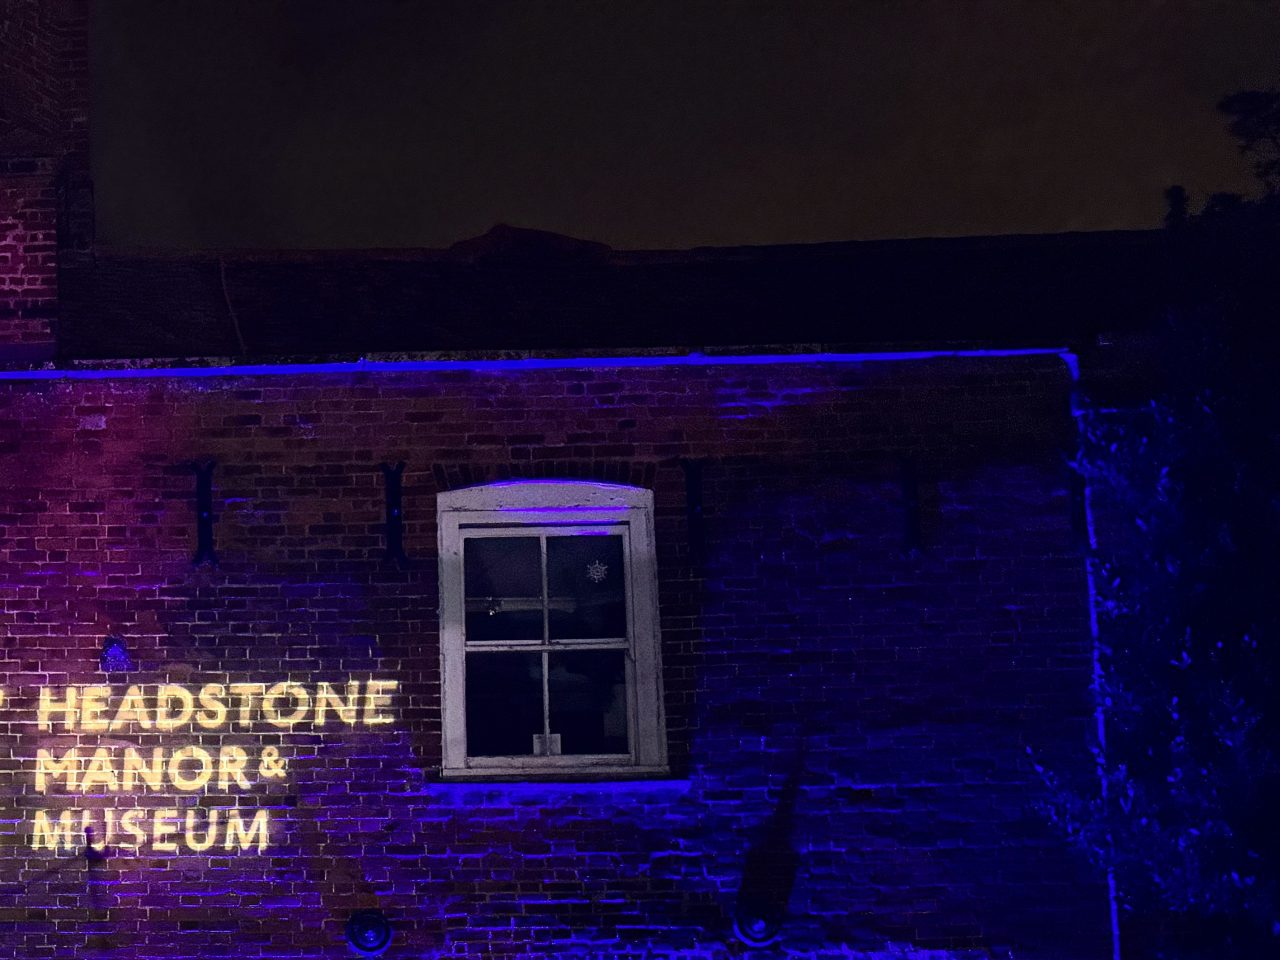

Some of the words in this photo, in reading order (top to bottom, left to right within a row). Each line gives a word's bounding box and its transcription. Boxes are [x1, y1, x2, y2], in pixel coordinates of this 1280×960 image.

[38, 680, 398, 731] HEADSTONE
[36, 746, 251, 792] MANOR
[259, 745, 288, 779] &
[33, 810, 270, 852] MUSEUM
